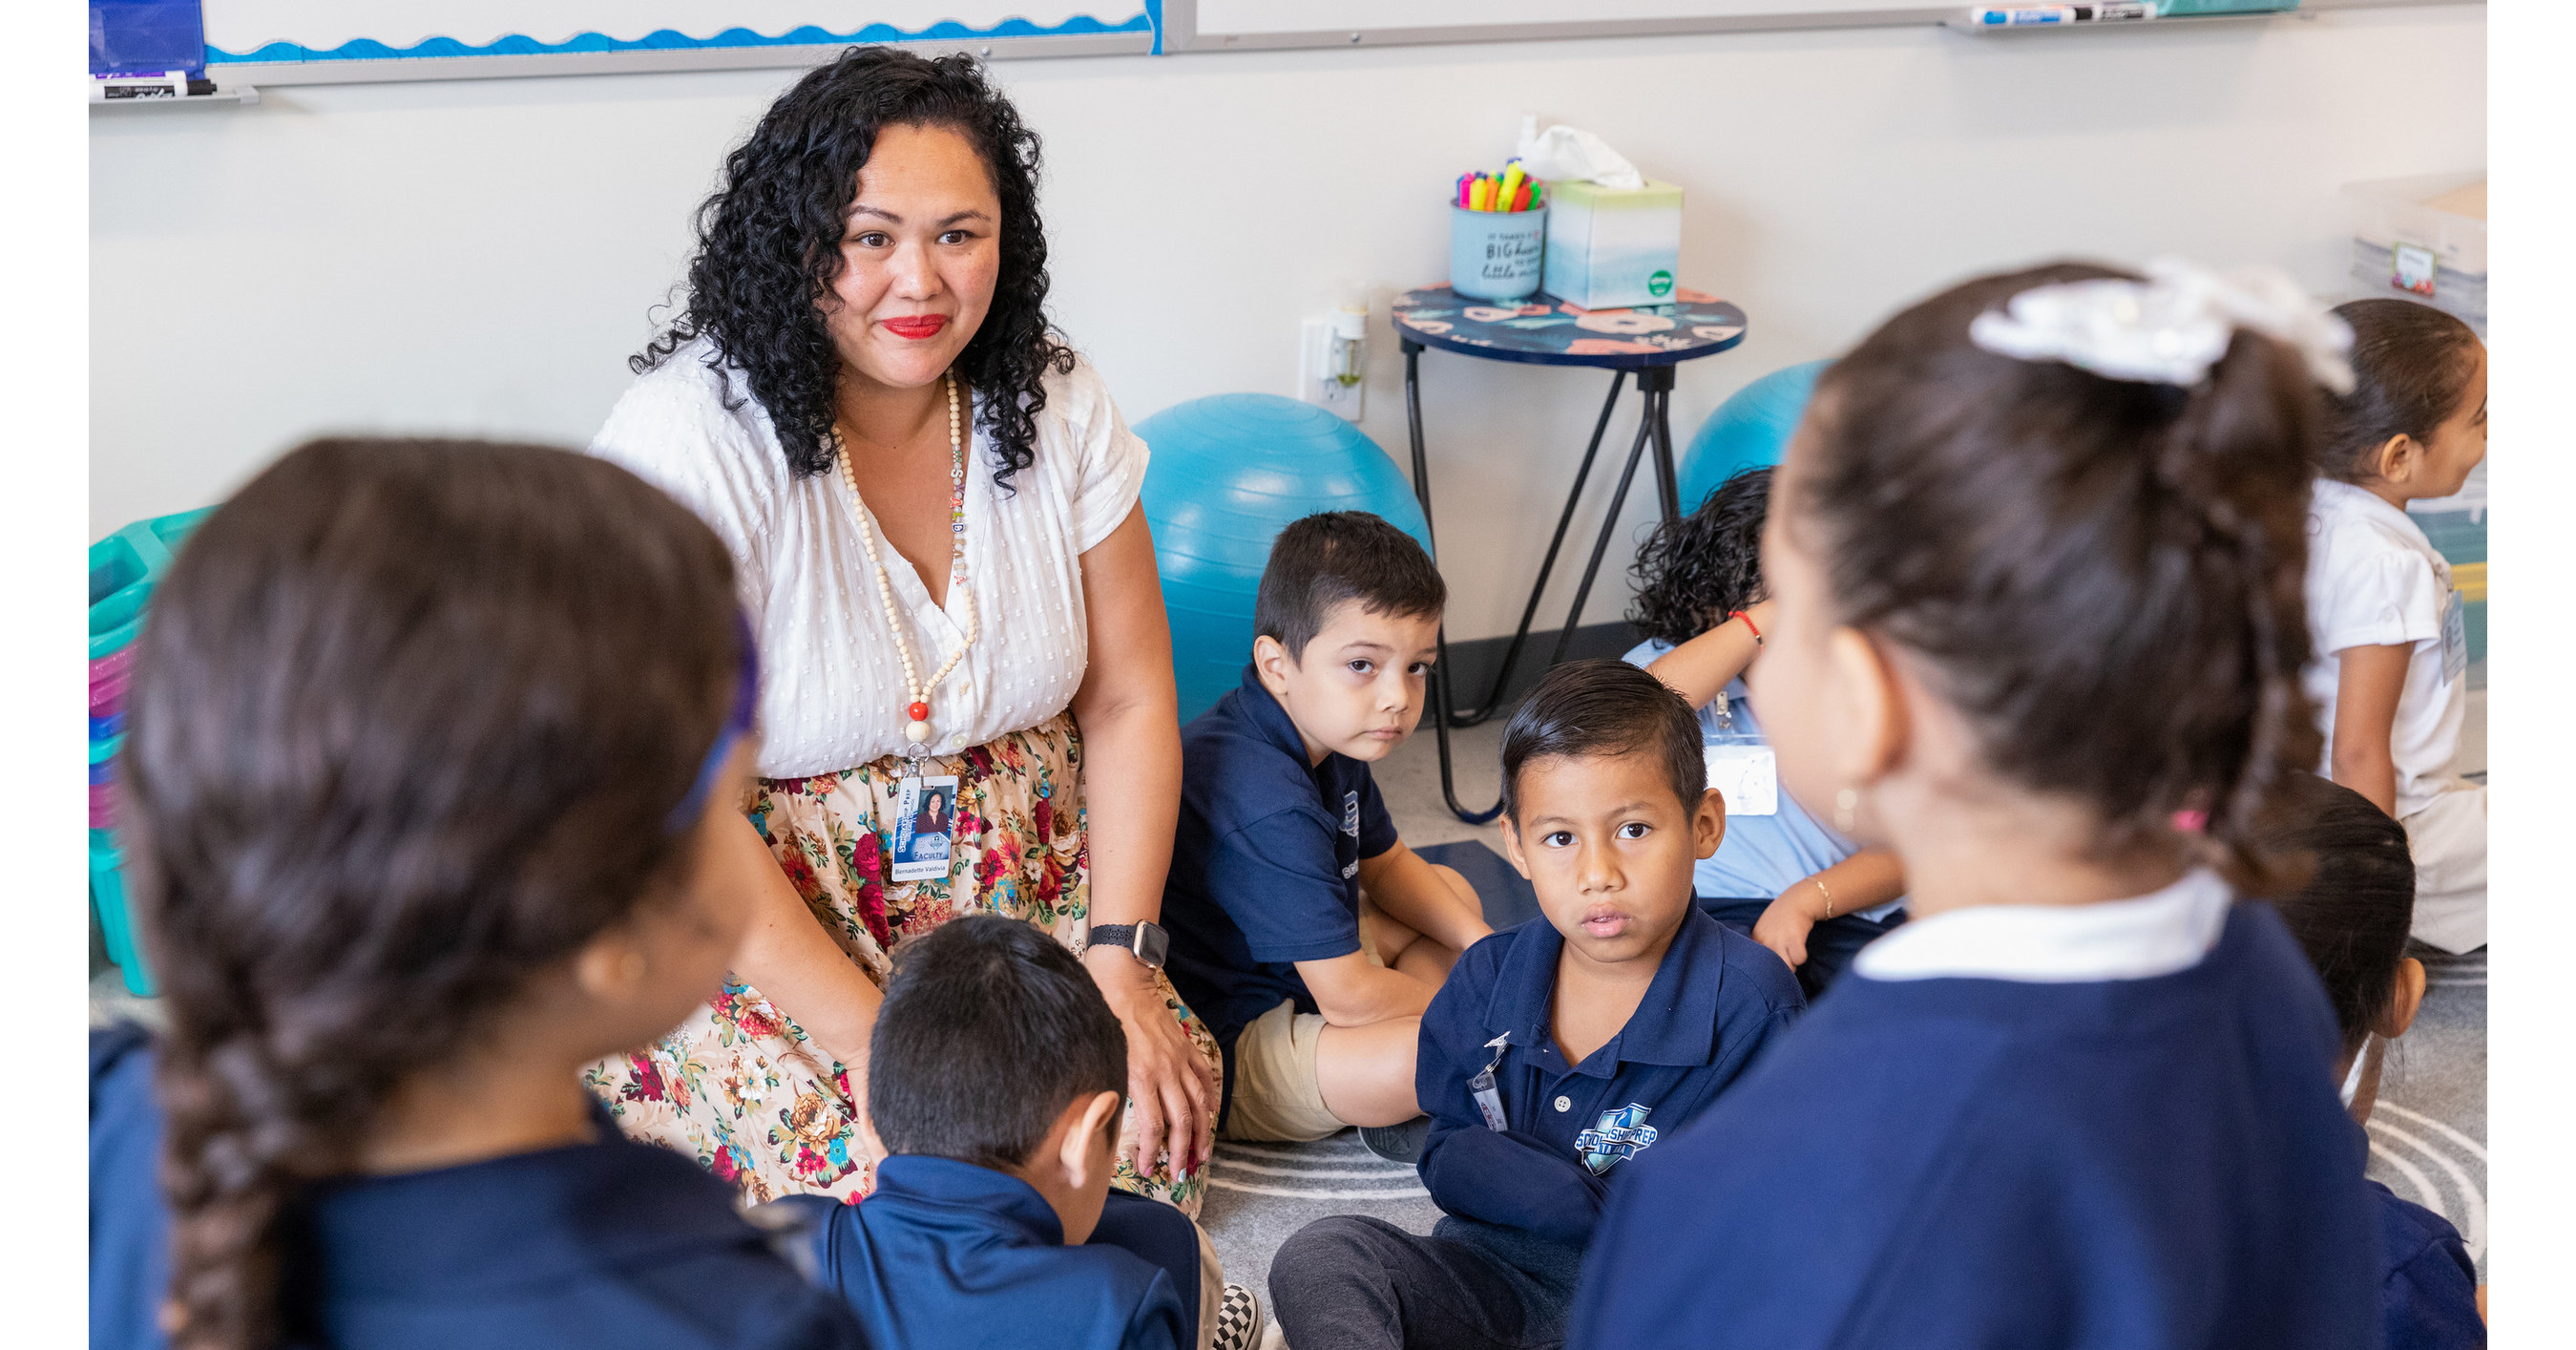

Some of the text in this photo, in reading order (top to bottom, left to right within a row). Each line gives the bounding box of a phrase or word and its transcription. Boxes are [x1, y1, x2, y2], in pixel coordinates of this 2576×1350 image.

[1486, 243, 1512, 260] BIG
[898, 808, 909, 852] SCHOLARSHIP
[1628, 1128, 1657, 1145] PREP
